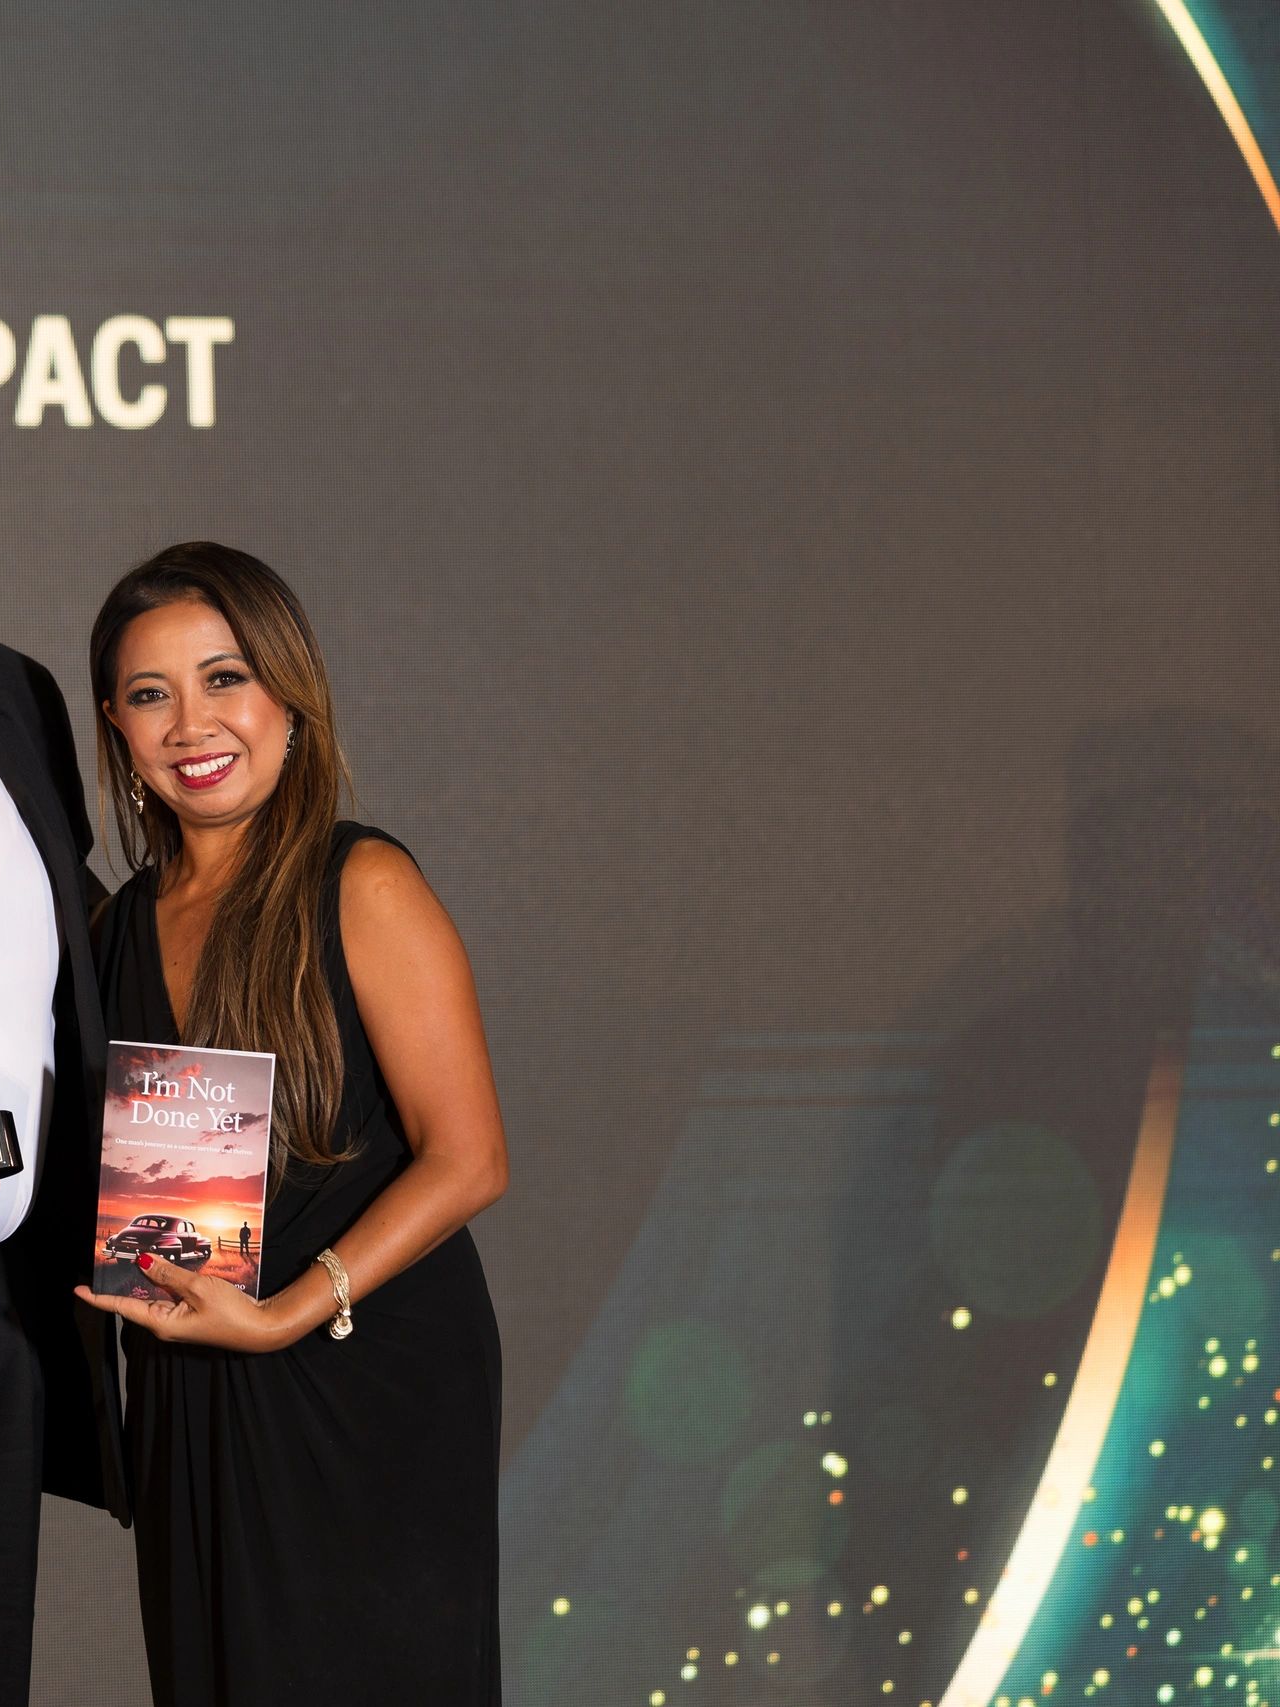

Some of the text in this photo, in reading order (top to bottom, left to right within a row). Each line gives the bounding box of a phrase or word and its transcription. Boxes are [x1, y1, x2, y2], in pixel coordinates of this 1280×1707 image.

[141, 1071, 236, 1103] I'm Not
[130, 1100, 243, 1133] Done Yet
